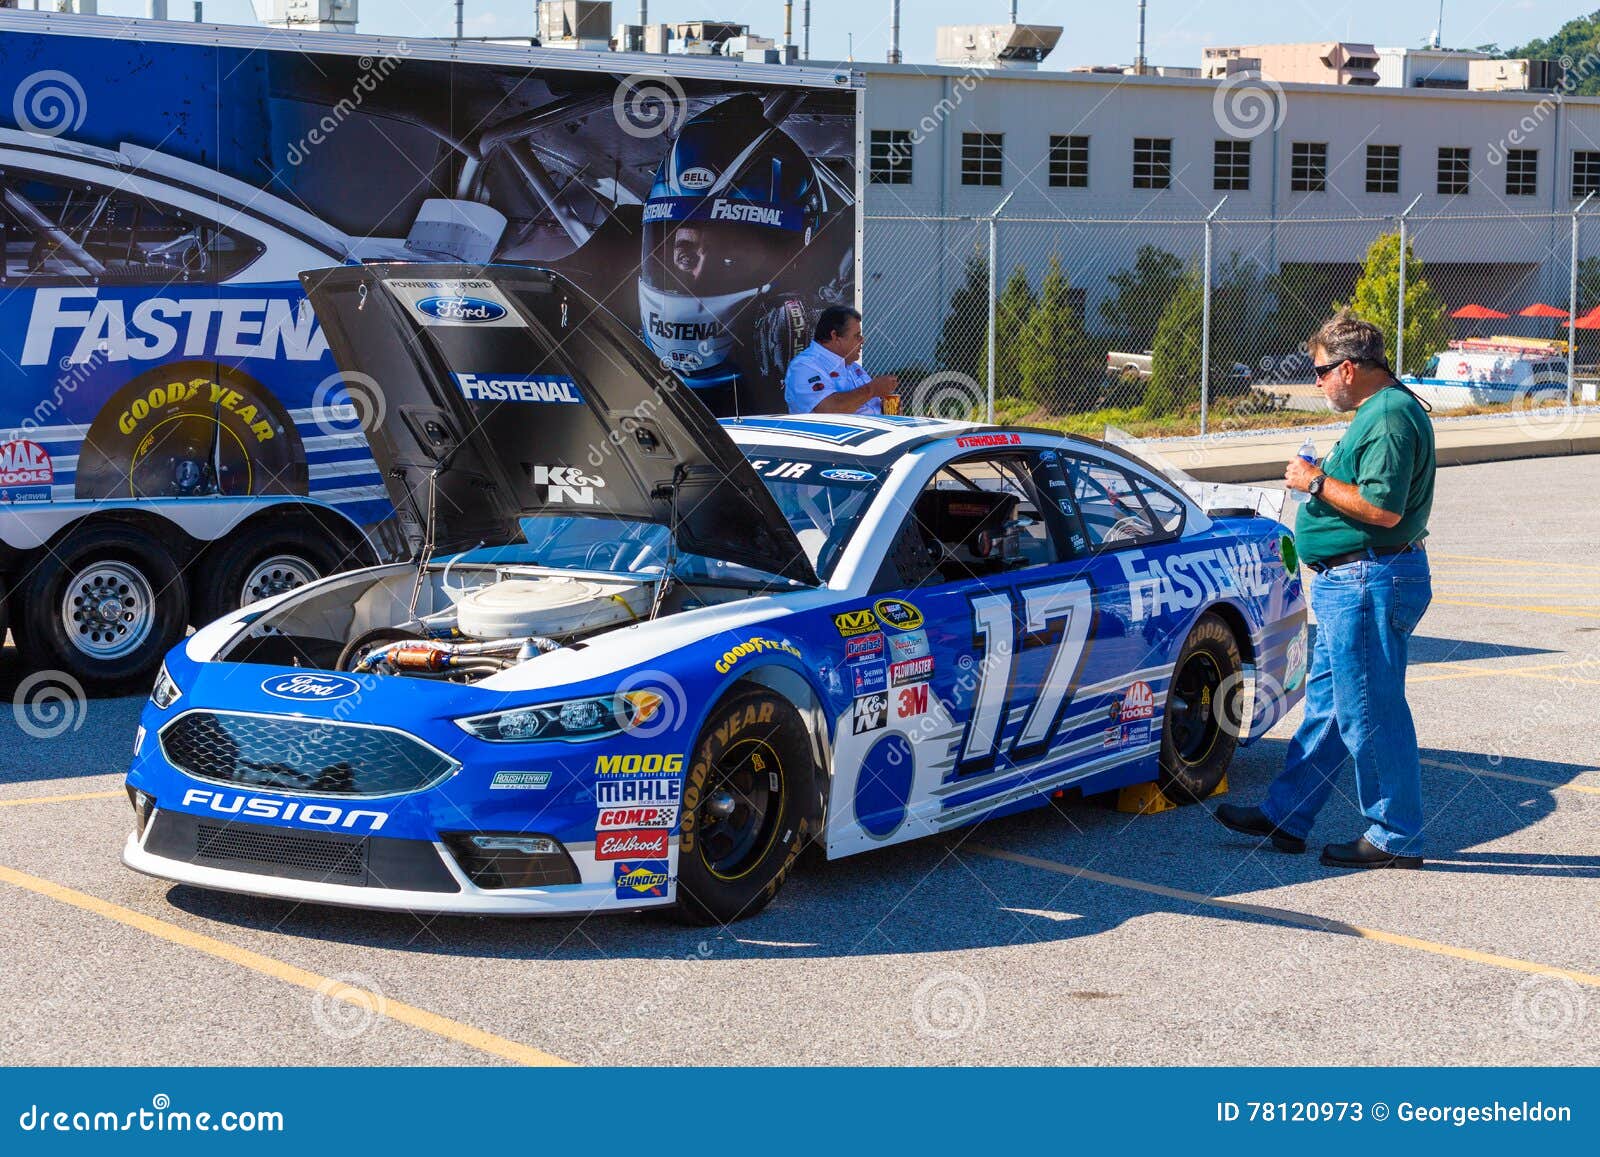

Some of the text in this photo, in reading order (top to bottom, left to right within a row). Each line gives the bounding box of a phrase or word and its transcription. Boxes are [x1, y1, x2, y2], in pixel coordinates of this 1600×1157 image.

[683, 172, 709, 182] BELL
[711, 198, 783, 226] FASTENAL
[390, 281, 442, 289] POWERED
[435, 299, 490, 319] Ford
[456, 373, 580, 403] FASTENAL
[118, 377, 275, 444] GOODYEAR
[764, 462, 812, 479] JR
[533, 465, 606, 505] K&N
[1113, 542, 1270, 622] FASTENAL
[715, 637, 803, 675] GOODYEAR
[892, 658, 932, 685] FLOWMASTER
[960, 577, 1092, 764] 17
[276, 674, 344, 697] Ford
[897, 684, 929, 719] 3M
[1121, 707, 1153, 721] TOOLS
[594, 753, 684, 774] MOOG
[679, 702, 776, 853] GOODYEAR
[601, 779, 680, 803] MAHLE
[182, 788, 389, 830] FUSION
[601, 808, 658, 826] COMP
[601, 832, 663, 855] Edelbrock
[617, 872, 667, 888] SUNOCO
